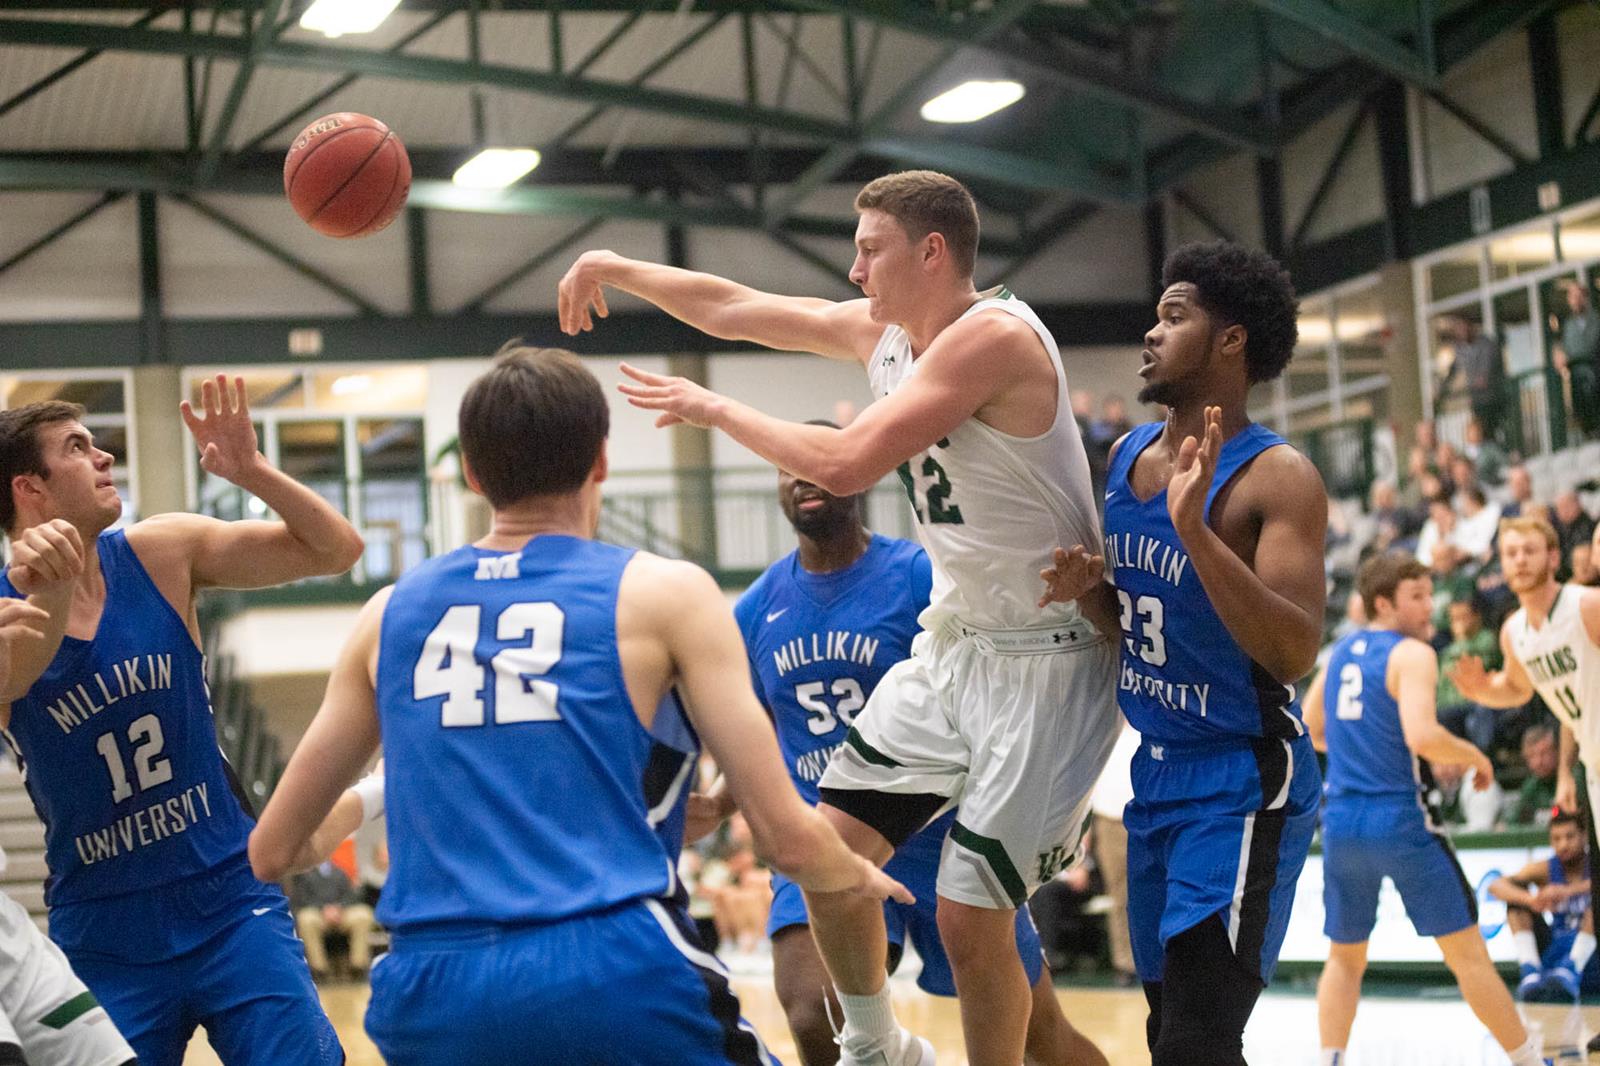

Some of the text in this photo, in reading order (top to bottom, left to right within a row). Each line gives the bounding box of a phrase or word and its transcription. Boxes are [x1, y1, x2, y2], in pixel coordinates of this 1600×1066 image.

[474, 552, 523, 581] M
[413, 601, 565, 728] 42
[773, 631, 879, 677] MILLIKIN
[47, 653, 172, 735] MILLIKIN
[795, 678, 866, 736] 52
[1336, 663, 1363, 720] 2
[96, 713, 173, 804] 12
[75, 782, 212, 865] UNIVERSITY
